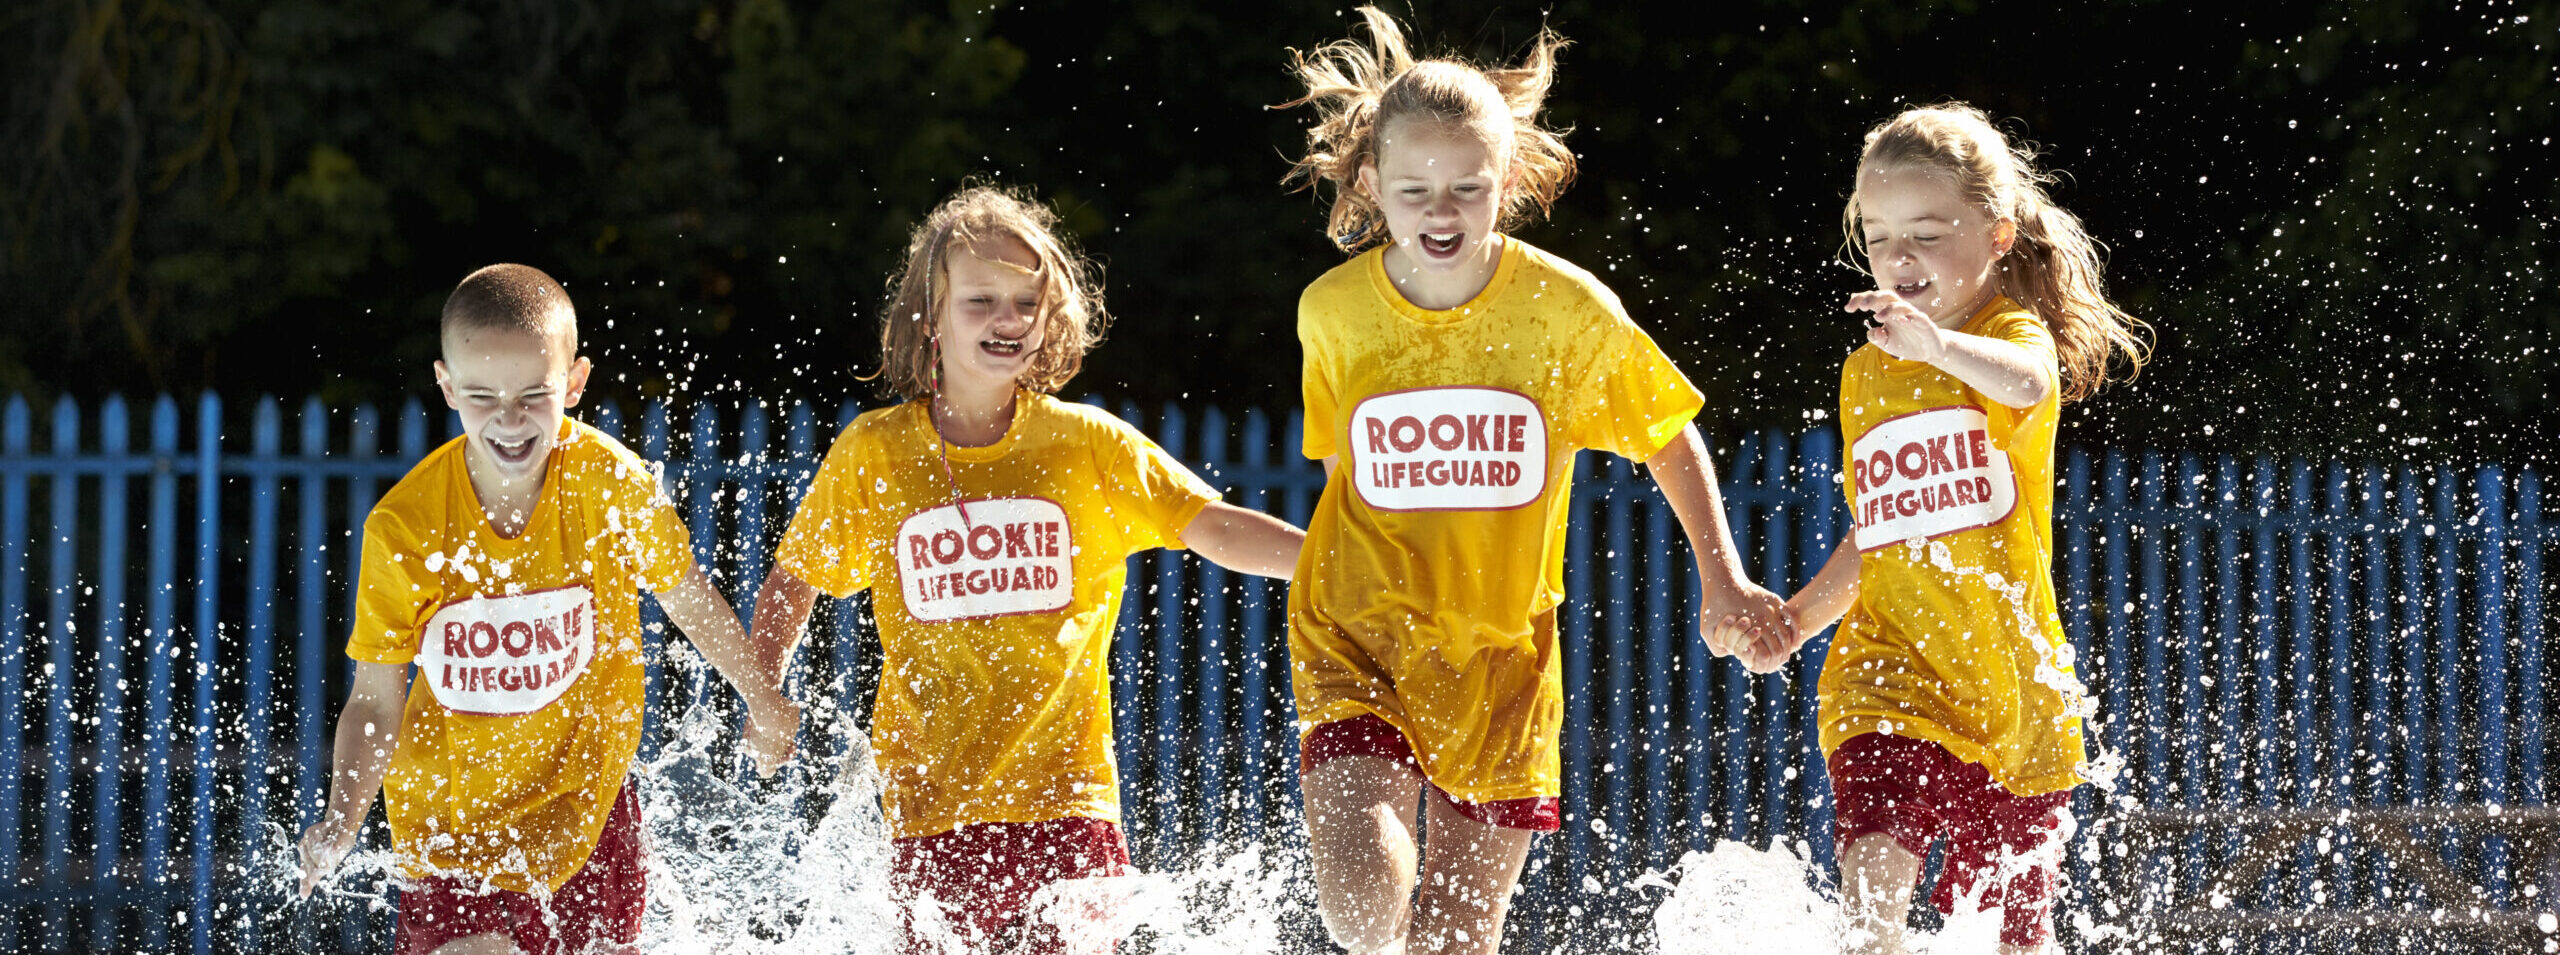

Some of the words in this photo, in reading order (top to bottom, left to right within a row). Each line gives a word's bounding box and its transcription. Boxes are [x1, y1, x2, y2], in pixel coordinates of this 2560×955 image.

[1366, 414, 1527, 454] ROOKIE
[1372, 460, 1521, 488] LIFEGUARD
[1853, 429, 1989, 497] ROOKIE
[1856, 476, 1992, 531] LIFEGUARD
[909, 522, 1059, 570] ROOKIE
[918, 565, 1059, 602] LIFEGUARD
[444, 602, 584, 658] ROOKIE
[442, 646, 578, 692] LIFEGUARD
